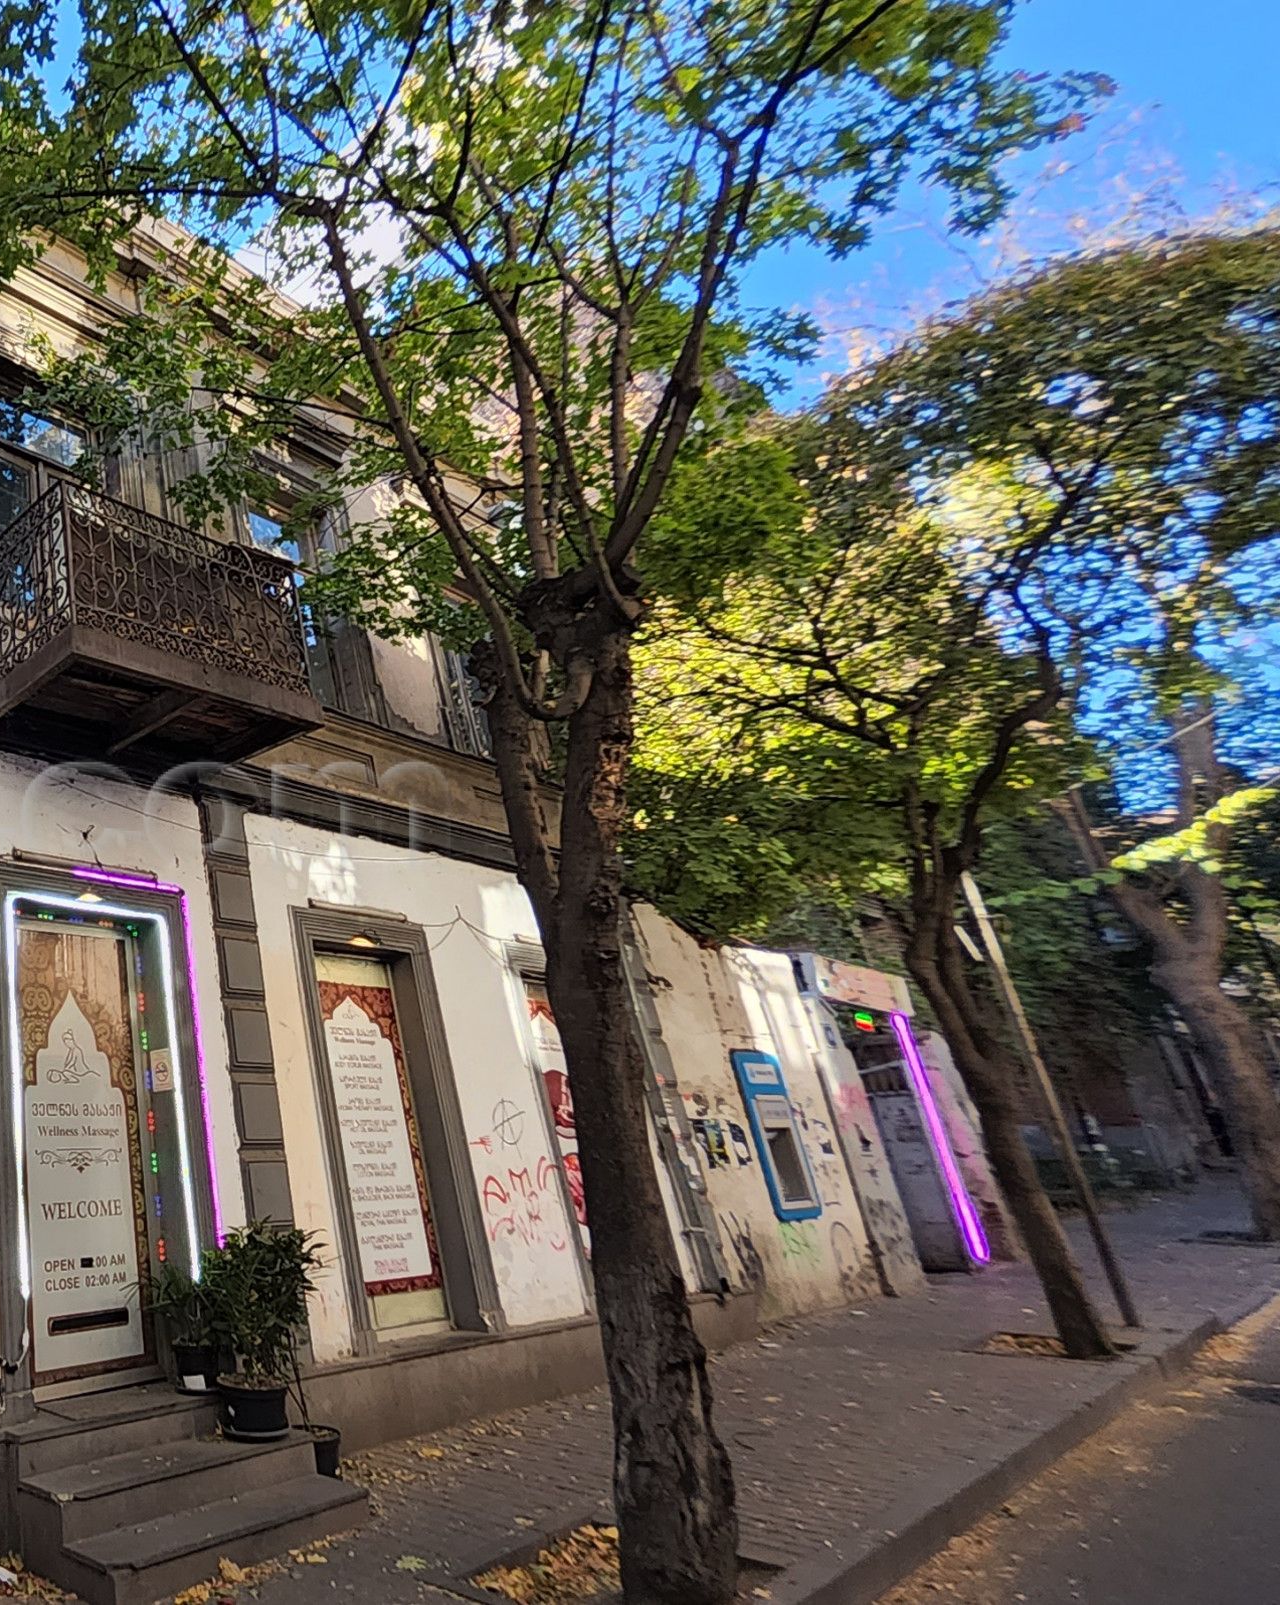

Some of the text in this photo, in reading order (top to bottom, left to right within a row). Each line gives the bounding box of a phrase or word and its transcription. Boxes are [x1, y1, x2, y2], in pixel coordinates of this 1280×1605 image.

[32, 1103, 123, 1117] ველნეს მასაჟი
[37, 1125, 120, 1138] Wellness Massage
[41, 1199, 123, 1221] WELCOME
[44, 1258, 76, 1273] OPEN
[110, 1254, 126, 1266] AM
[45, 1272, 127, 1292] CLOSE 02:00 AM
